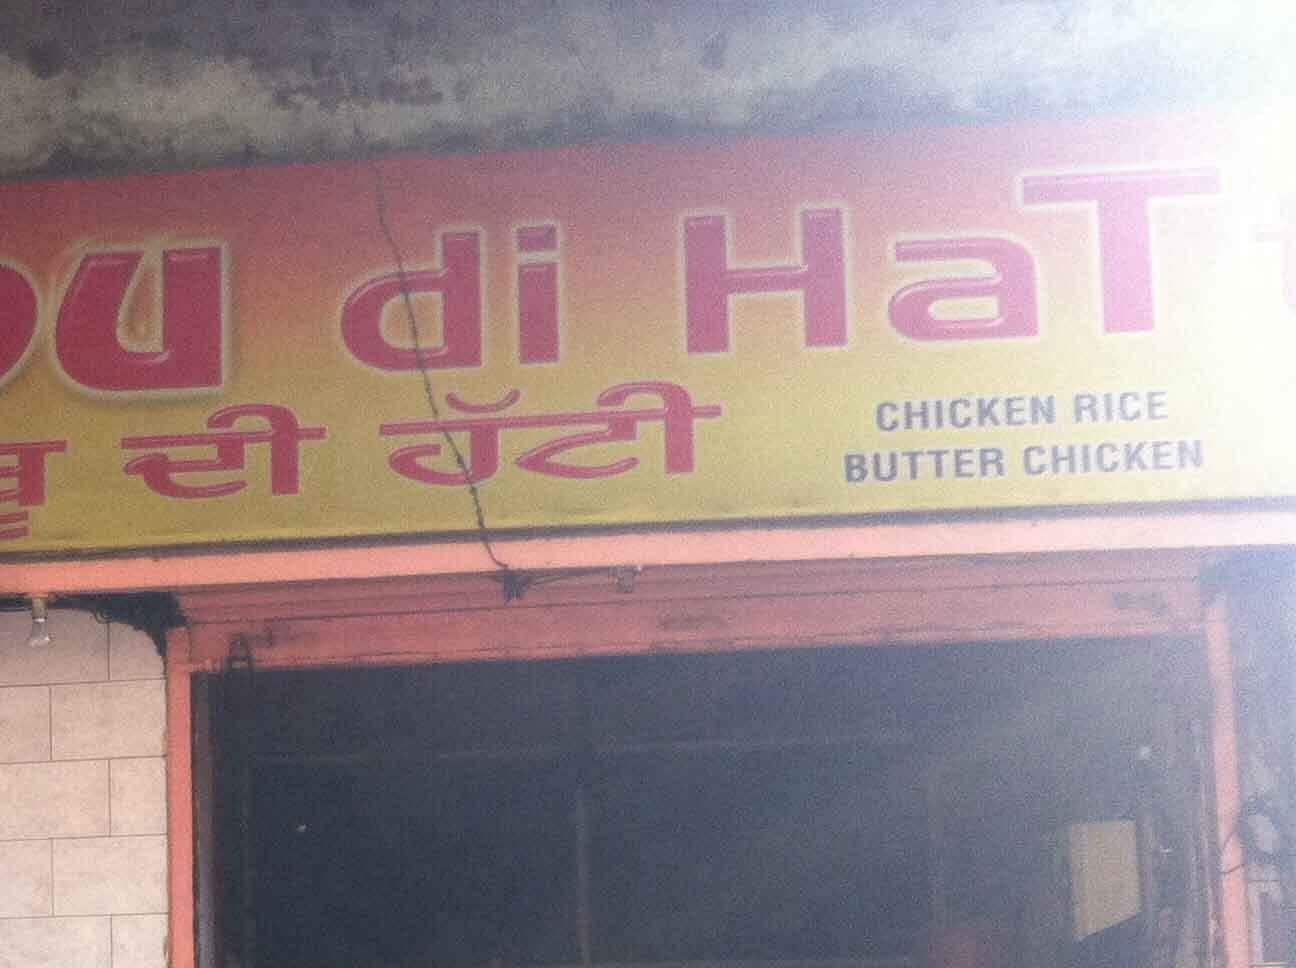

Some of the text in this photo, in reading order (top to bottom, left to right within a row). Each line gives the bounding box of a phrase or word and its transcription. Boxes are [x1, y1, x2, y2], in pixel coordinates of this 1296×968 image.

[340, 222, 562, 372] di
[682, 170, 1296, 356] HaT
[119, 403, 327, 496] ਦੀ
[379, 380, 722, 486] ਹੱਟੀ
[874, 390, 1169, 432] CHICKEN RICE
[843, 439, 1204, 483] BUTTER CHICKEN
